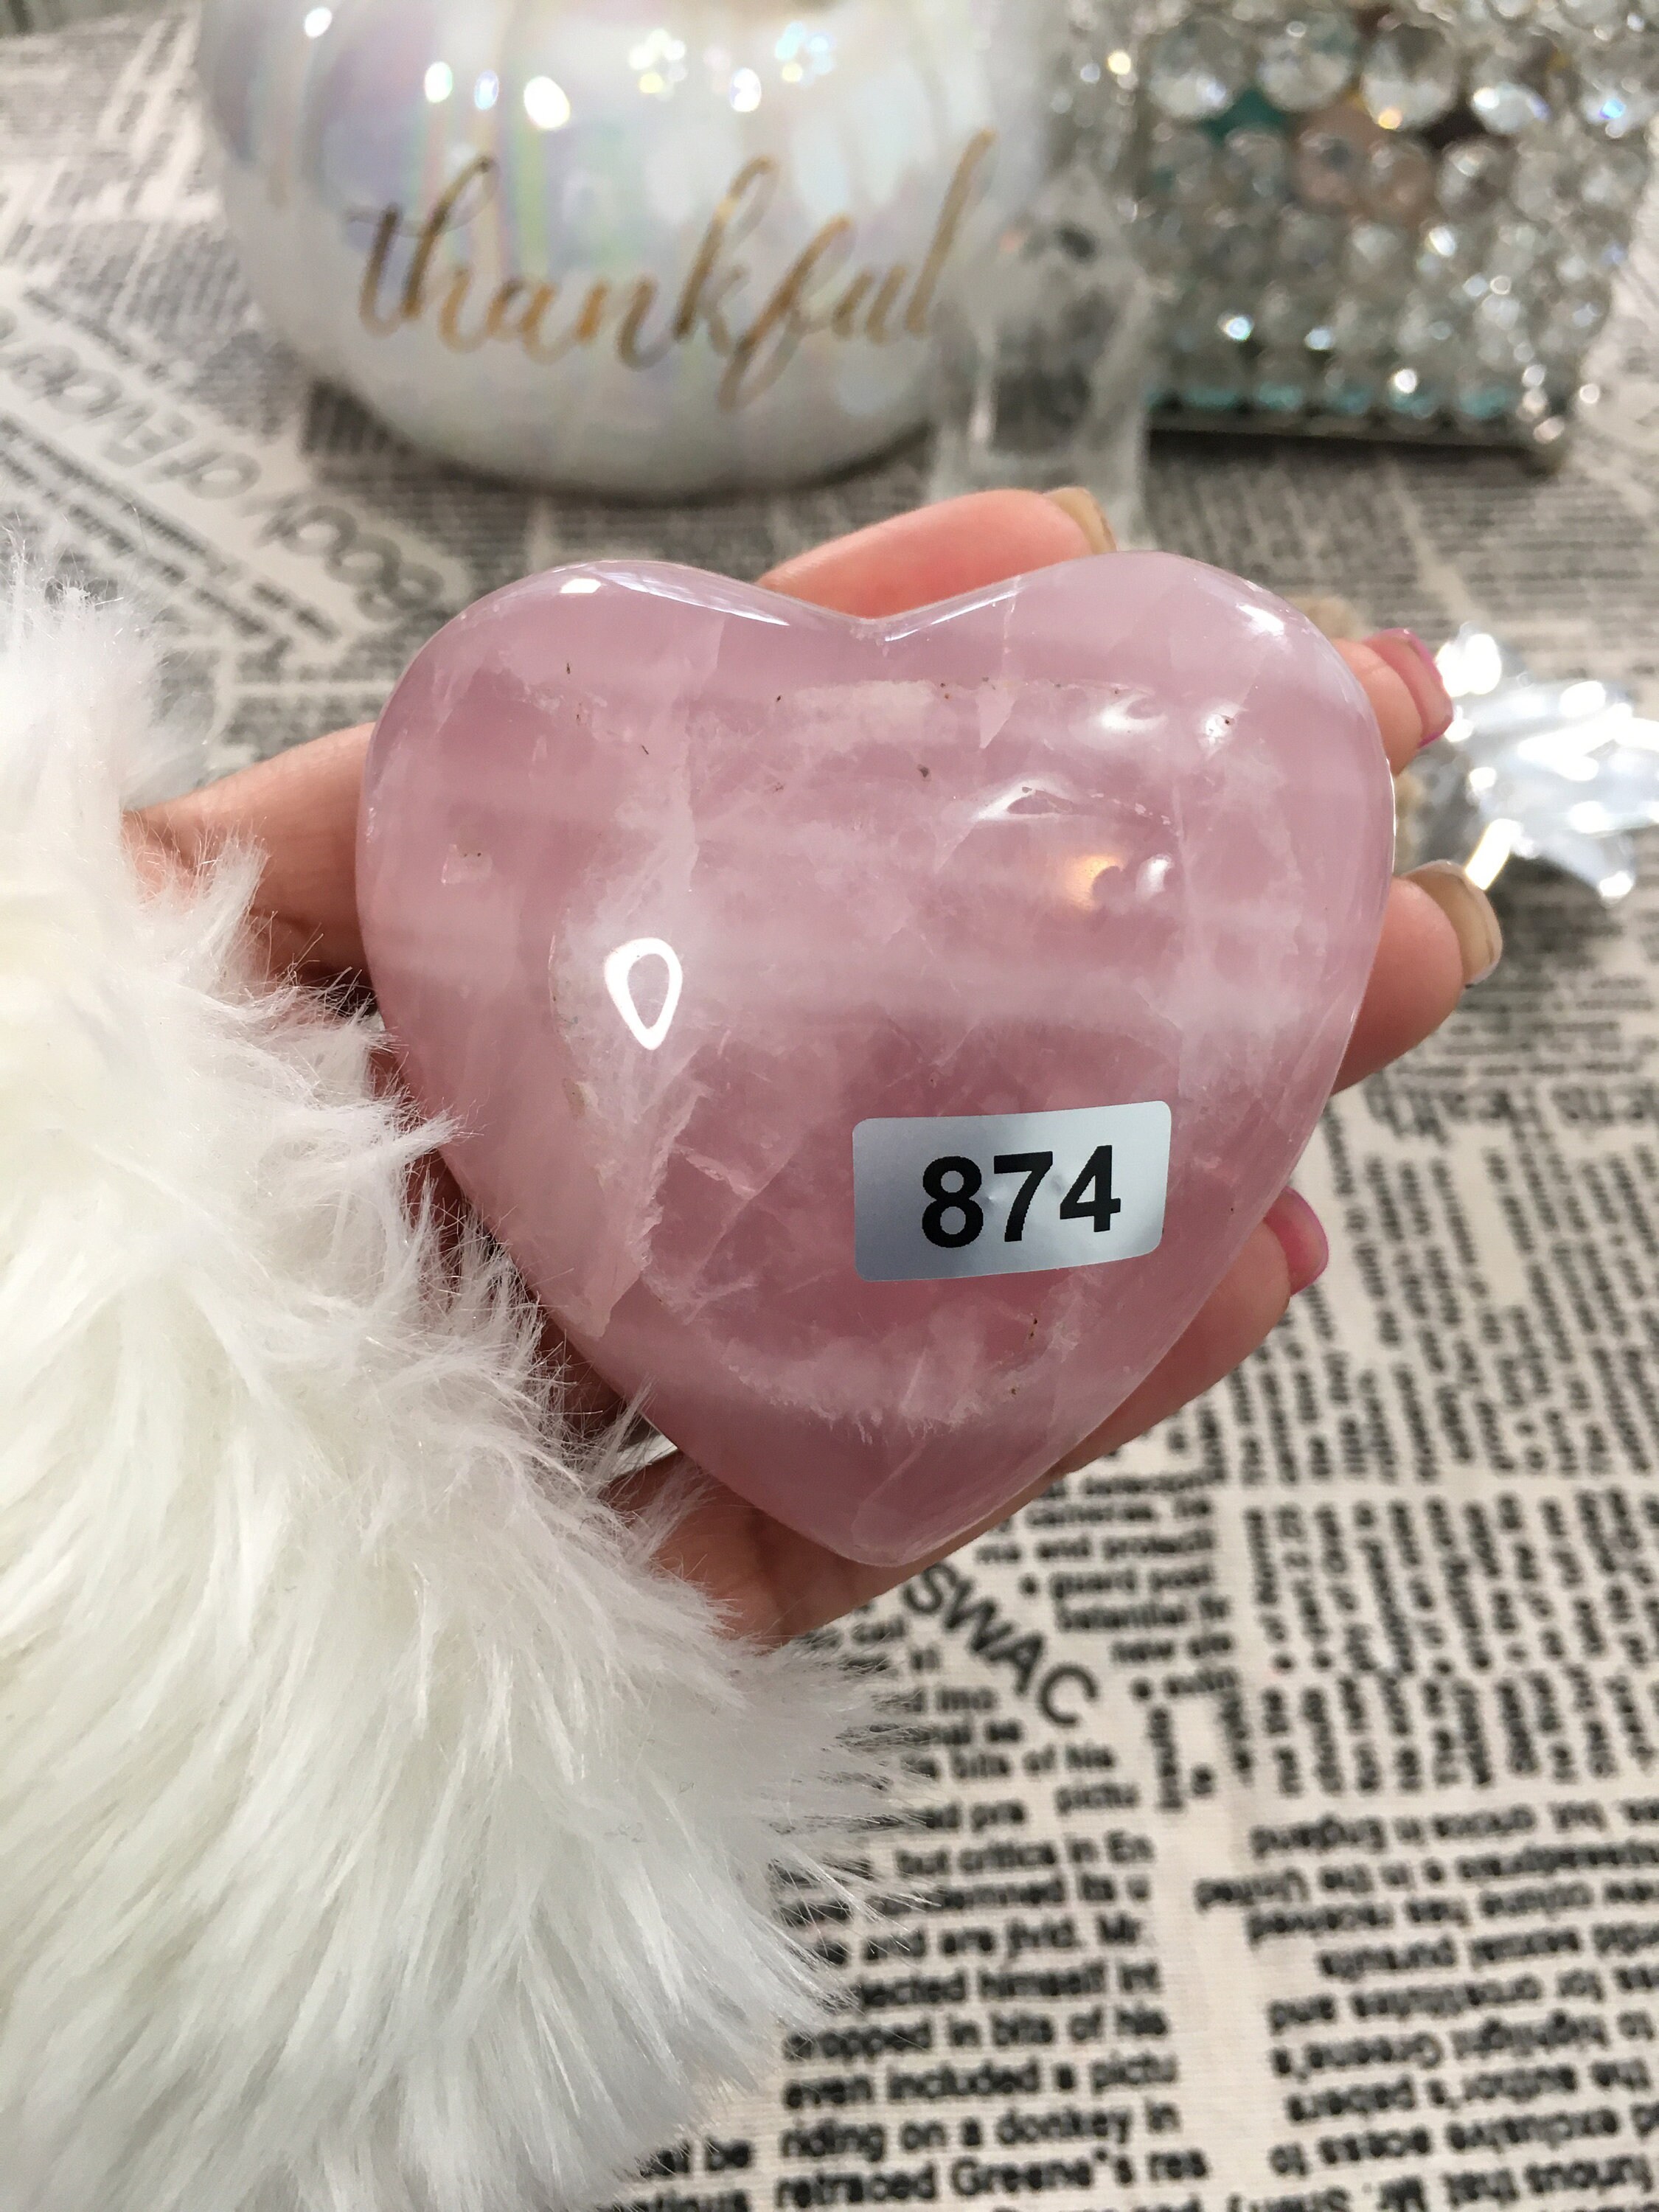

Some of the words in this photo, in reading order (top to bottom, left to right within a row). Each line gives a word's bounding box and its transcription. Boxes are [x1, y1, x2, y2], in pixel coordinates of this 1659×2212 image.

[347, 129, 997, 411] thankful
[921, 1144, 1121, 1248] 874
[901, 1560, 1099, 1728] SWAC
[886, 2059, 1039, 2099] included
[995, 2106, 1133, 2148] donkey
